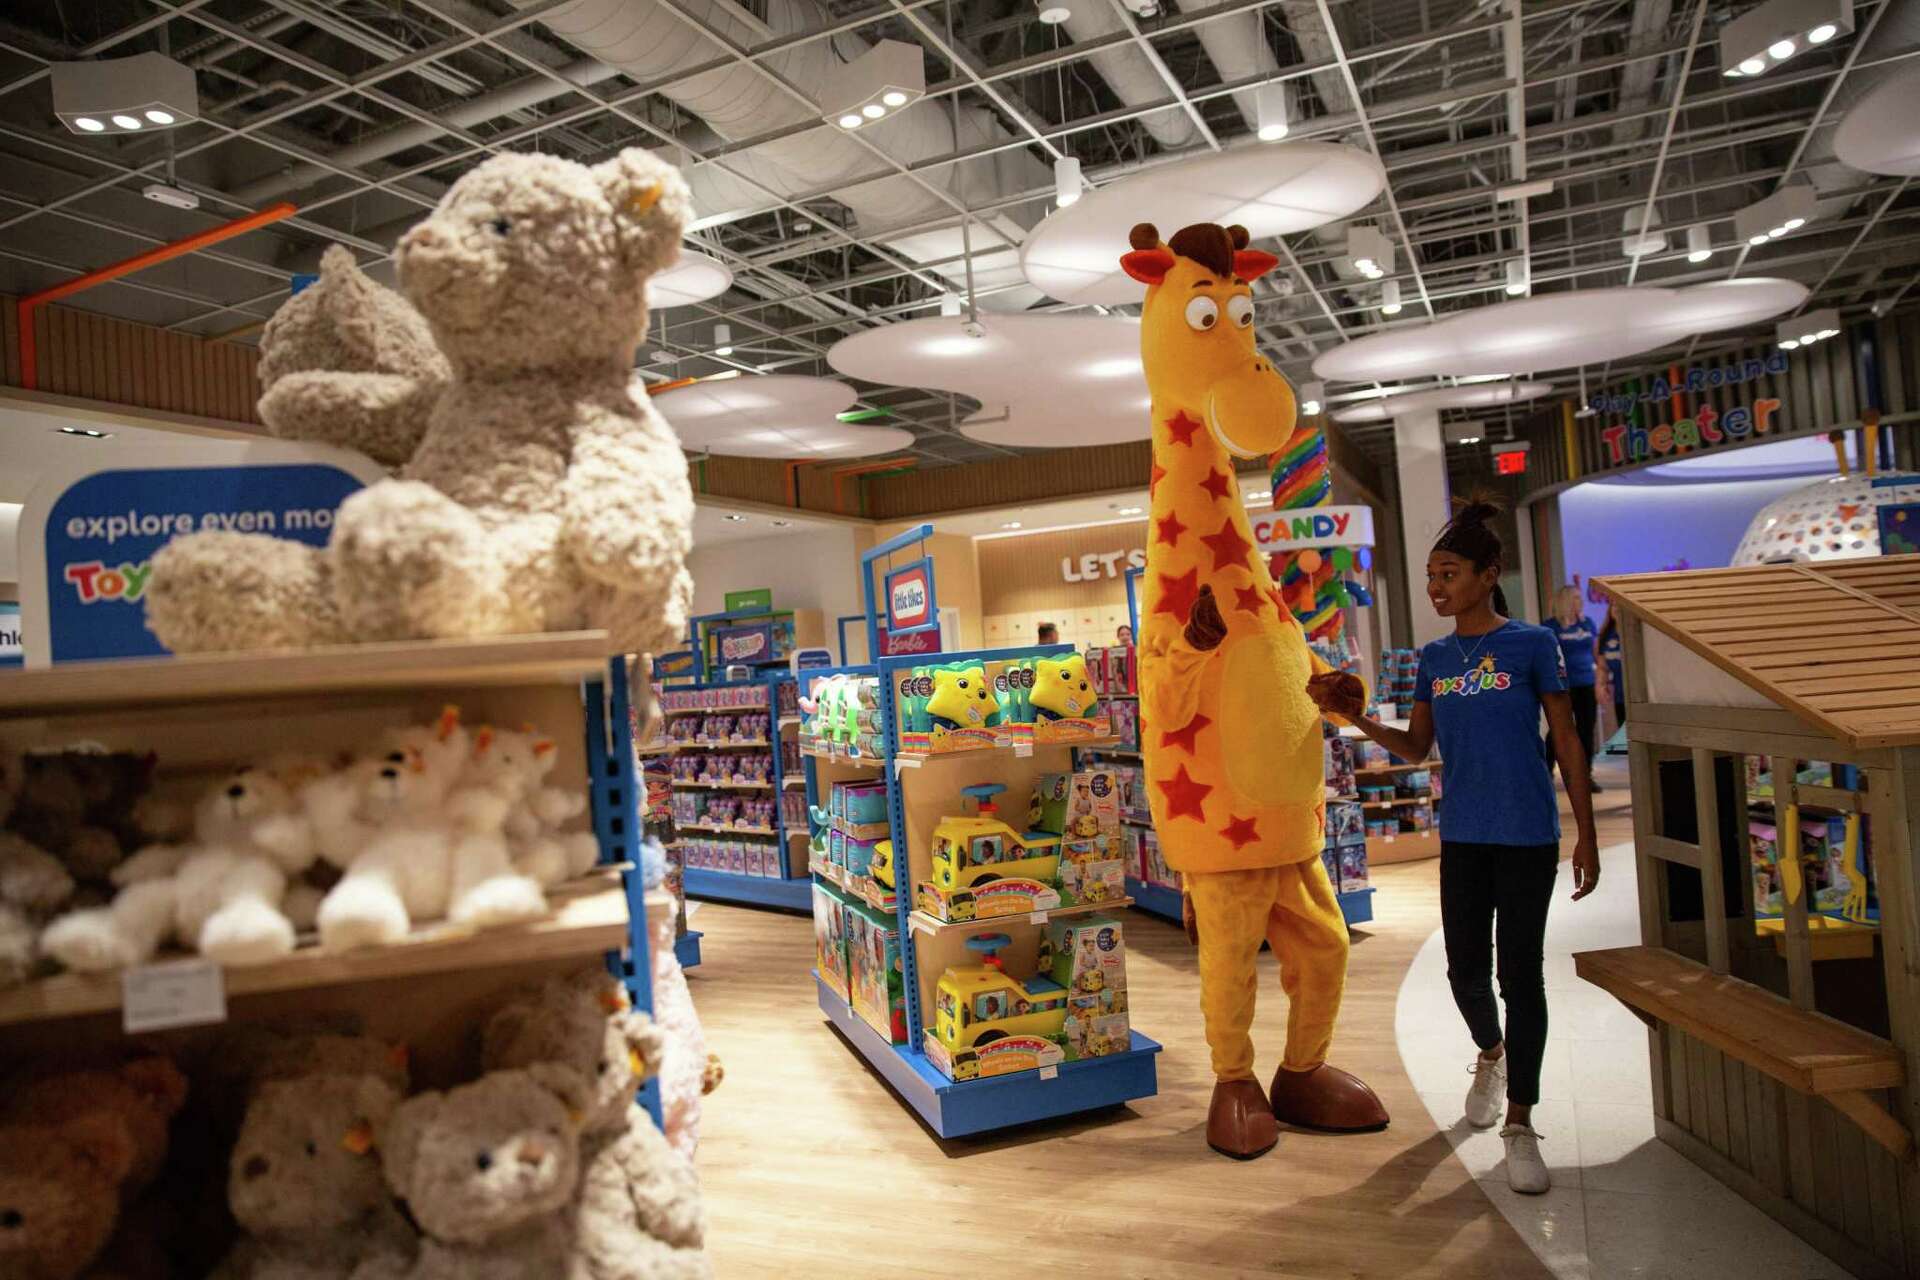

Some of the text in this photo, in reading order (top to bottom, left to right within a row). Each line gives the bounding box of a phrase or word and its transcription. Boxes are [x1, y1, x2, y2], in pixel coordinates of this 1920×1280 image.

[1602, 398, 1781, 463] Theater
[66, 510, 193, 544] explore
[201, 508, 276, 532] even
[1255, 513, 1350, 544] CANDY
